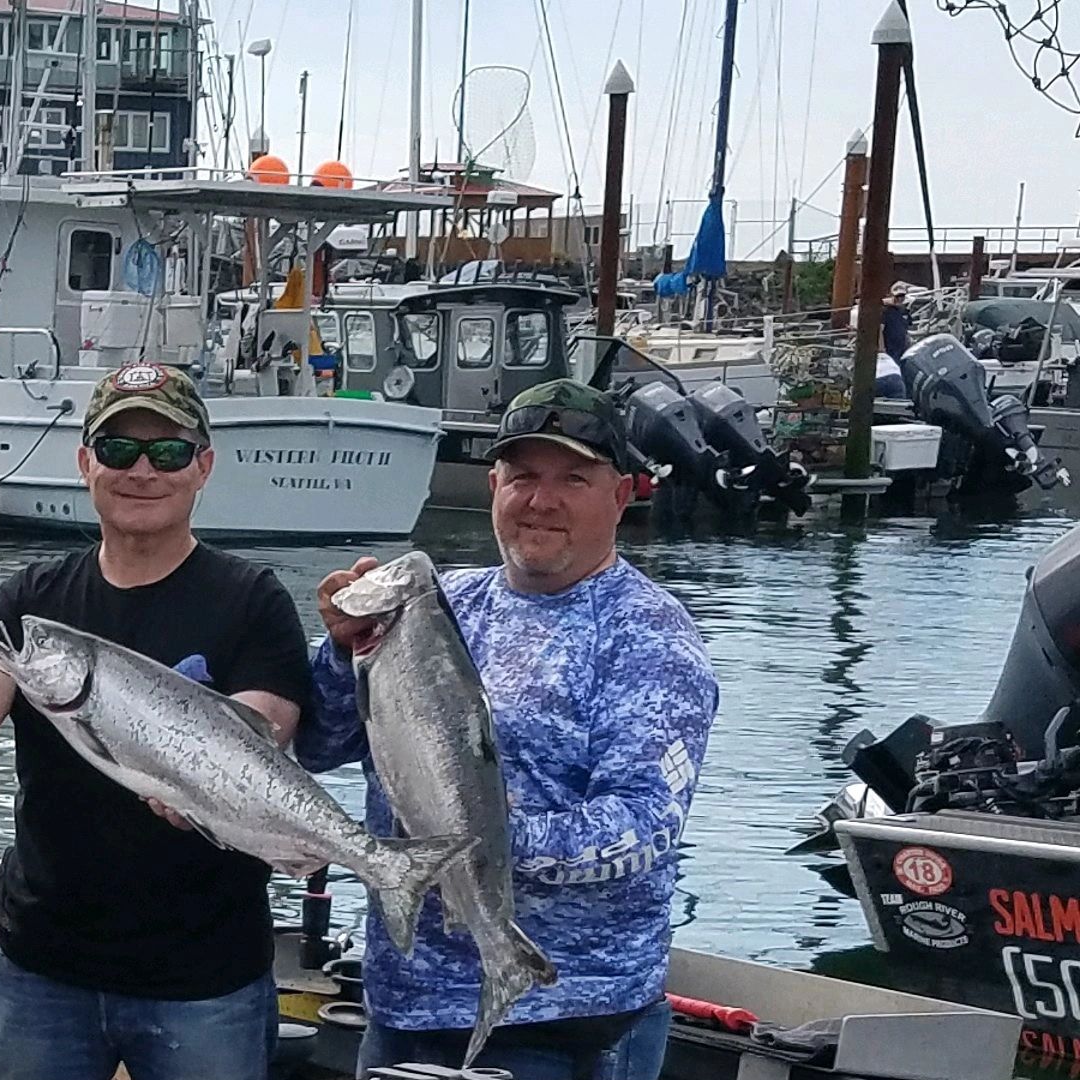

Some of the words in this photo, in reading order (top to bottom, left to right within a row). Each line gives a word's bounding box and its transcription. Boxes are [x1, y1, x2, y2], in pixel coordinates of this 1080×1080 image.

[908, 860, 936, 882] 18
[899, 900, 933, 916] ROUGH
[934, 902, 967, 922] RIVER
